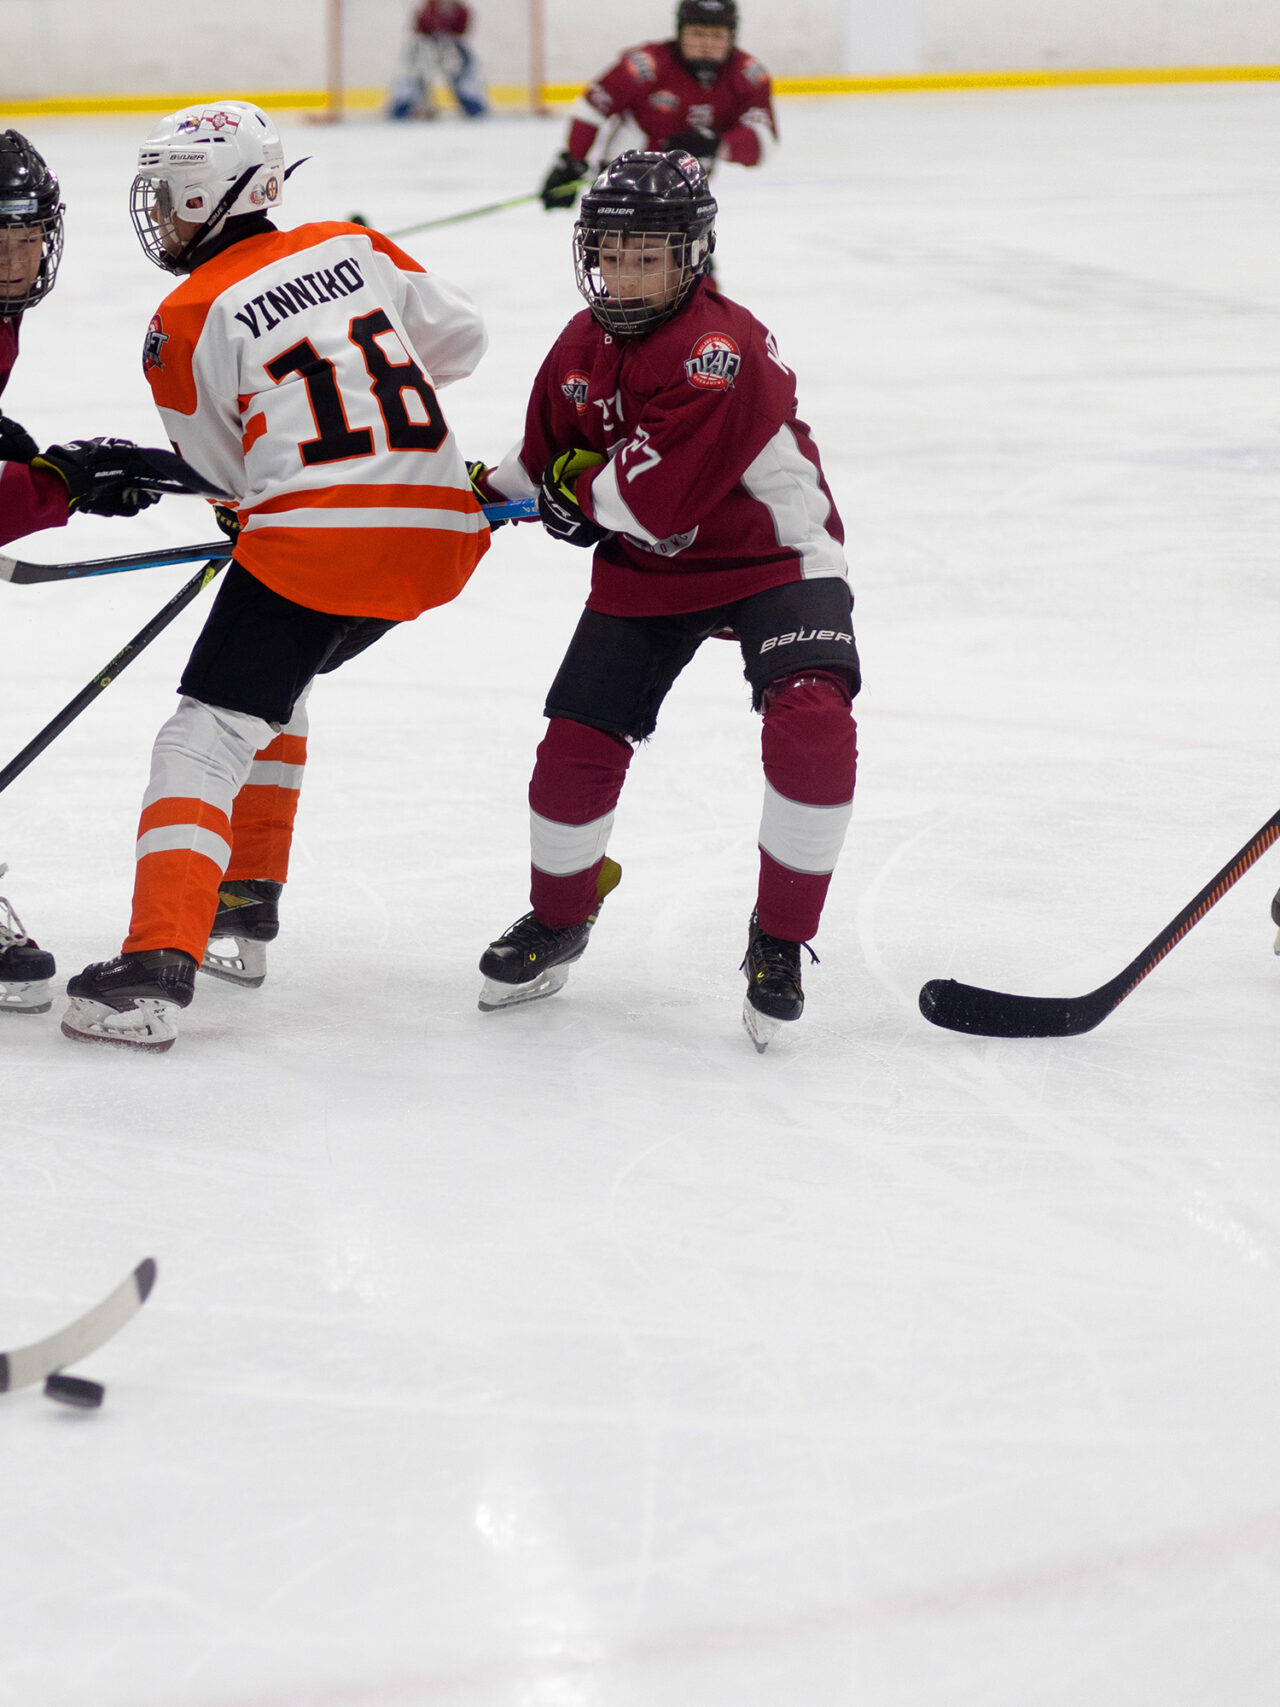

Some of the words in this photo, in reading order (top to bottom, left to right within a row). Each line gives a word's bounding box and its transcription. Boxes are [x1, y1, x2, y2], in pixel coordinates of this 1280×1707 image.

[597, 207, 635, 215] BAUER
[234, 257, 364, 339] VINNIKO
[263, 308, 449, 467] 18
[759, 629, 853, 654] BAUER
